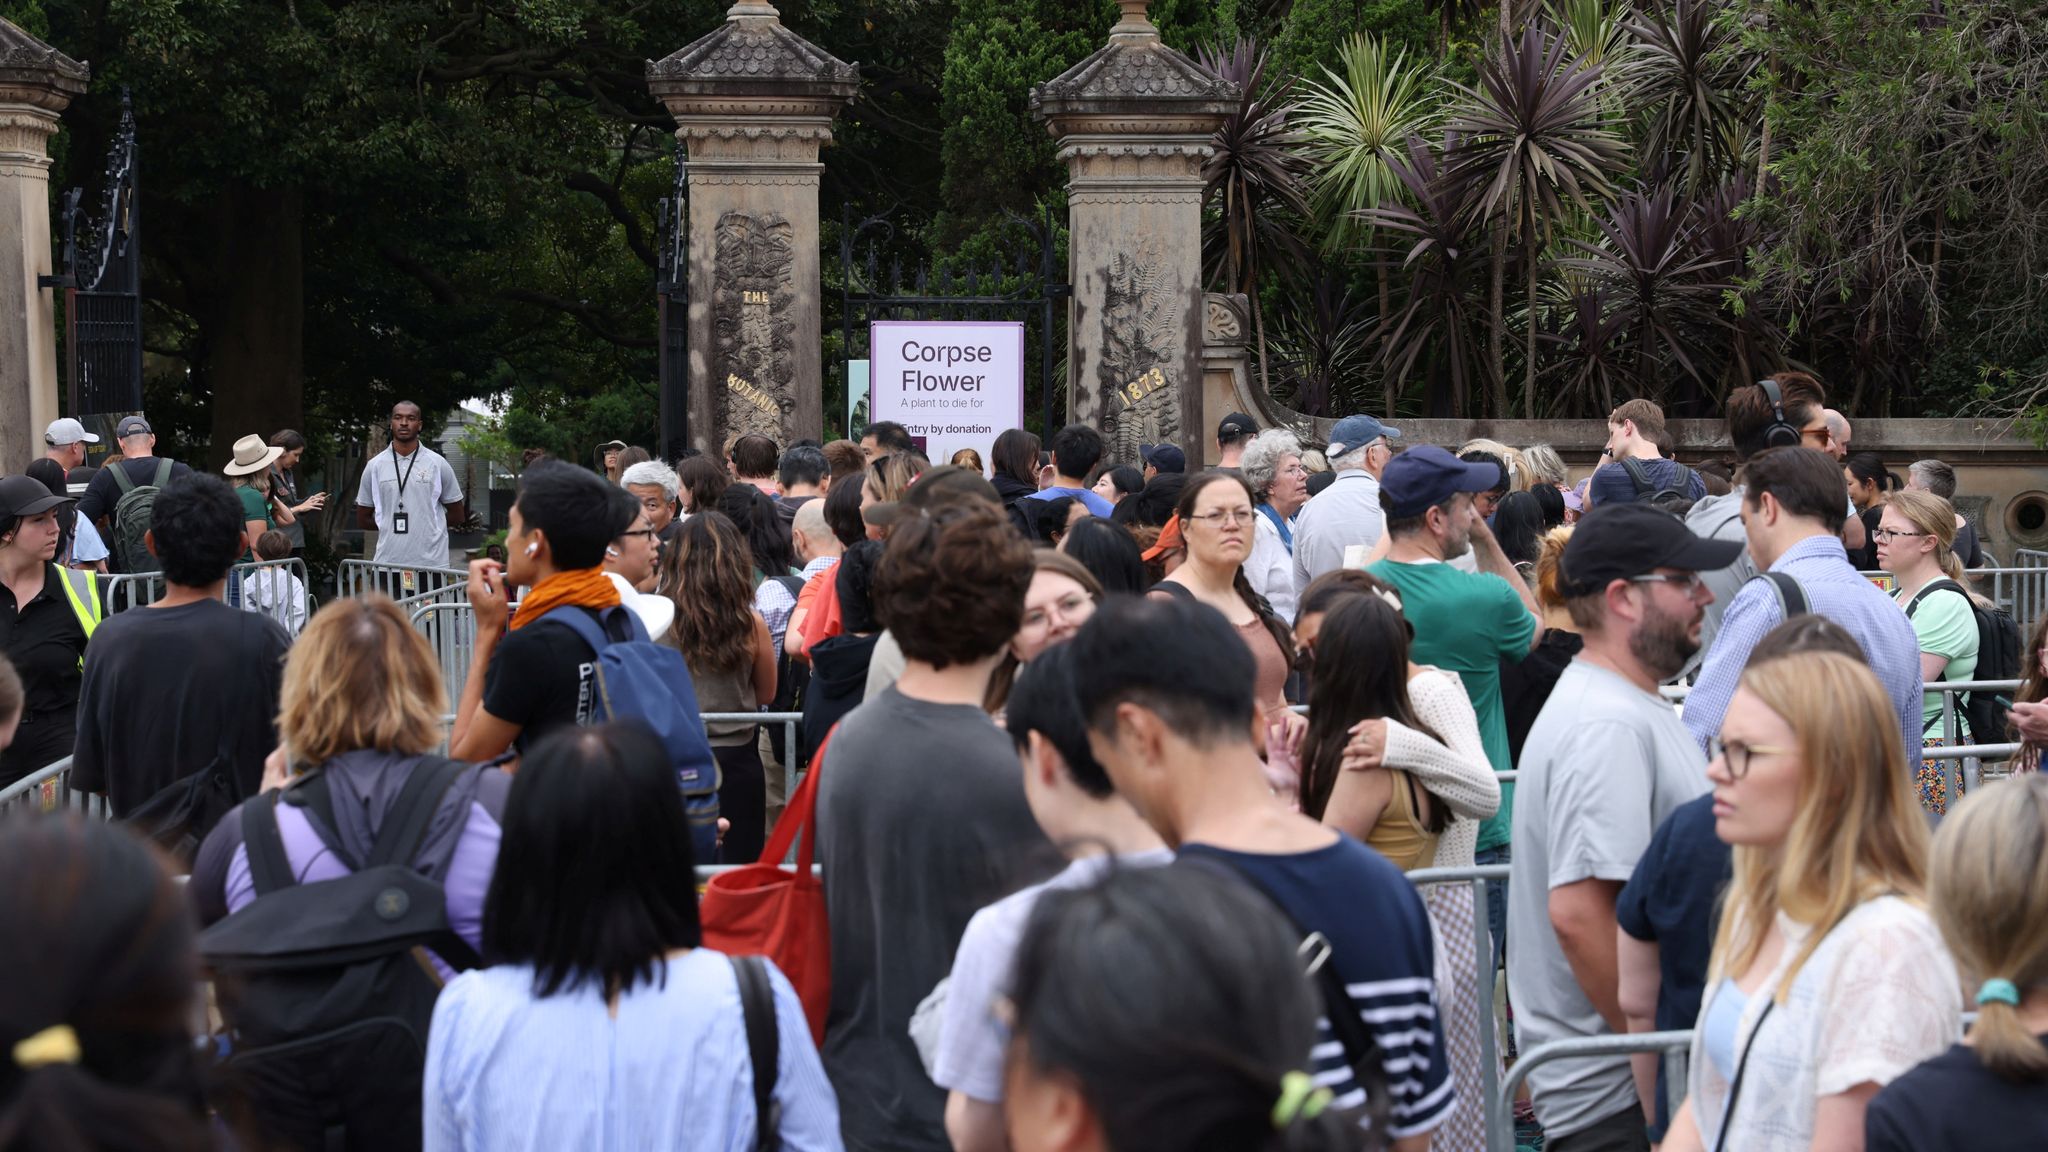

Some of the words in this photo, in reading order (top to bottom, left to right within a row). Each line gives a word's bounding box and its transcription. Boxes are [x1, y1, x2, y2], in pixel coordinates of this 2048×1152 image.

[743, 291, 769, 304] THE
[902, 340, 992, 367] Corpse
[902, 370, 985, 392] Flower
[1118, 367, 1166, 408] 1873
[900, 398, 909, 408] A
[911, 398, 936, 410] plant
[939, 399, 950, 408] to
[952, 398, 968, 408] die
[970, 398, 984, 408] for
[931, 424, 944, 436] by
[945, 424, 992, 434] donation
